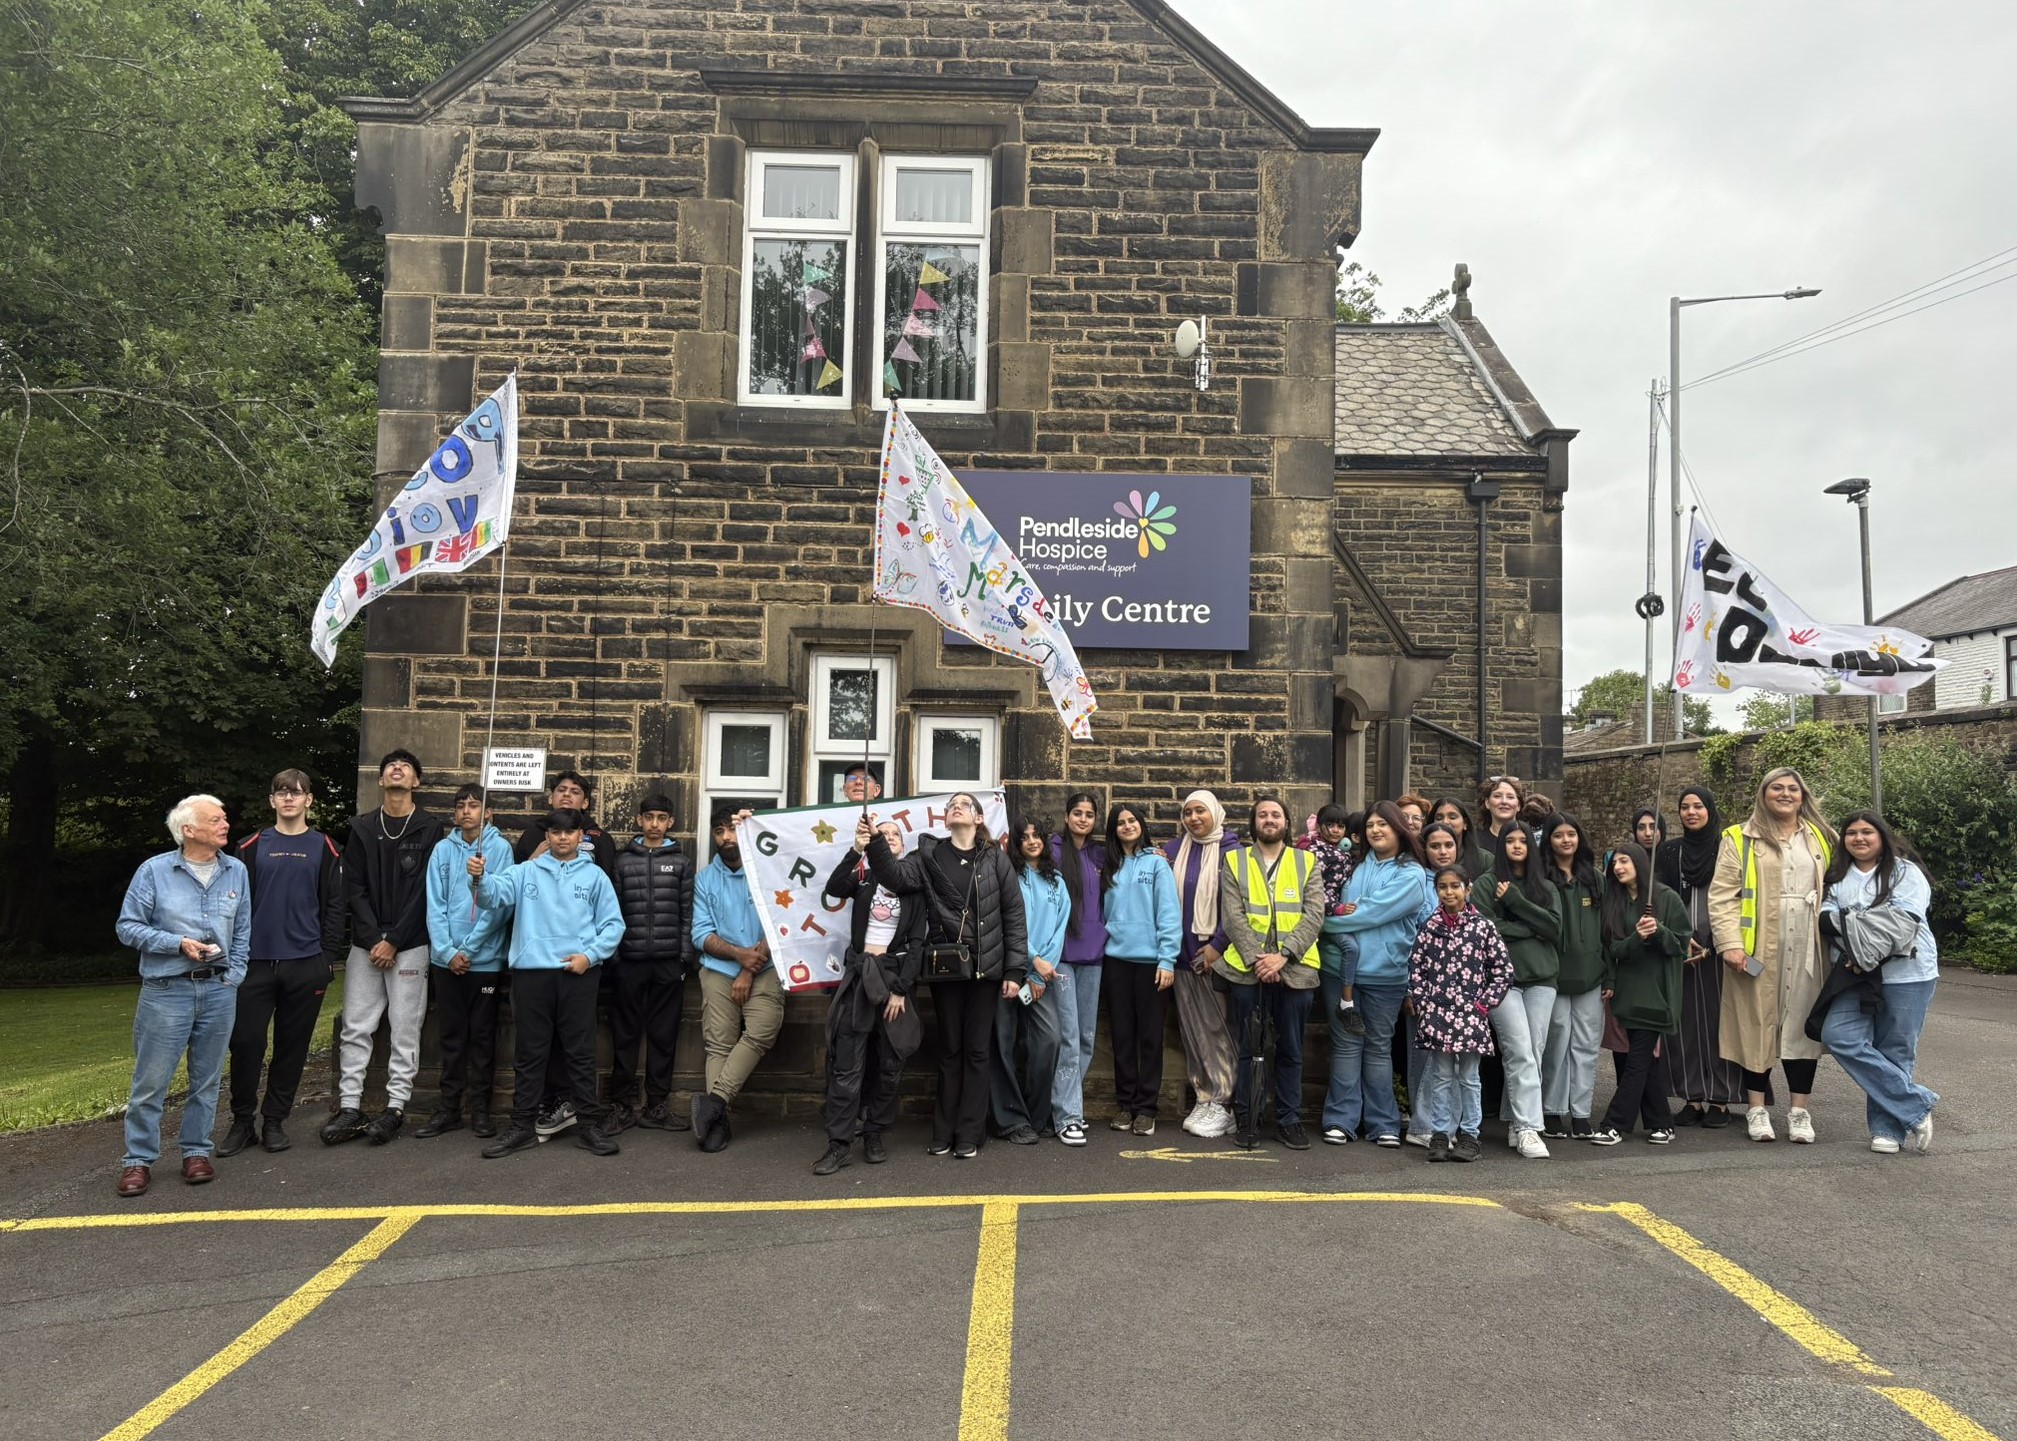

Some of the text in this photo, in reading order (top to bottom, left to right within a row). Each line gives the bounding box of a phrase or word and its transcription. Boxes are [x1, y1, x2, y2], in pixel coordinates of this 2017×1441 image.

[1020, 516, 1139, 539] Pendleside
[1019, 537, 1108, 563] Hospice
[1043, 562, 1087, 576] compassion
[1088, 559, 1107, 572] and
[1107, 562, 1137, 577] support
[1052, 593, 1211, 627] ily Centre
